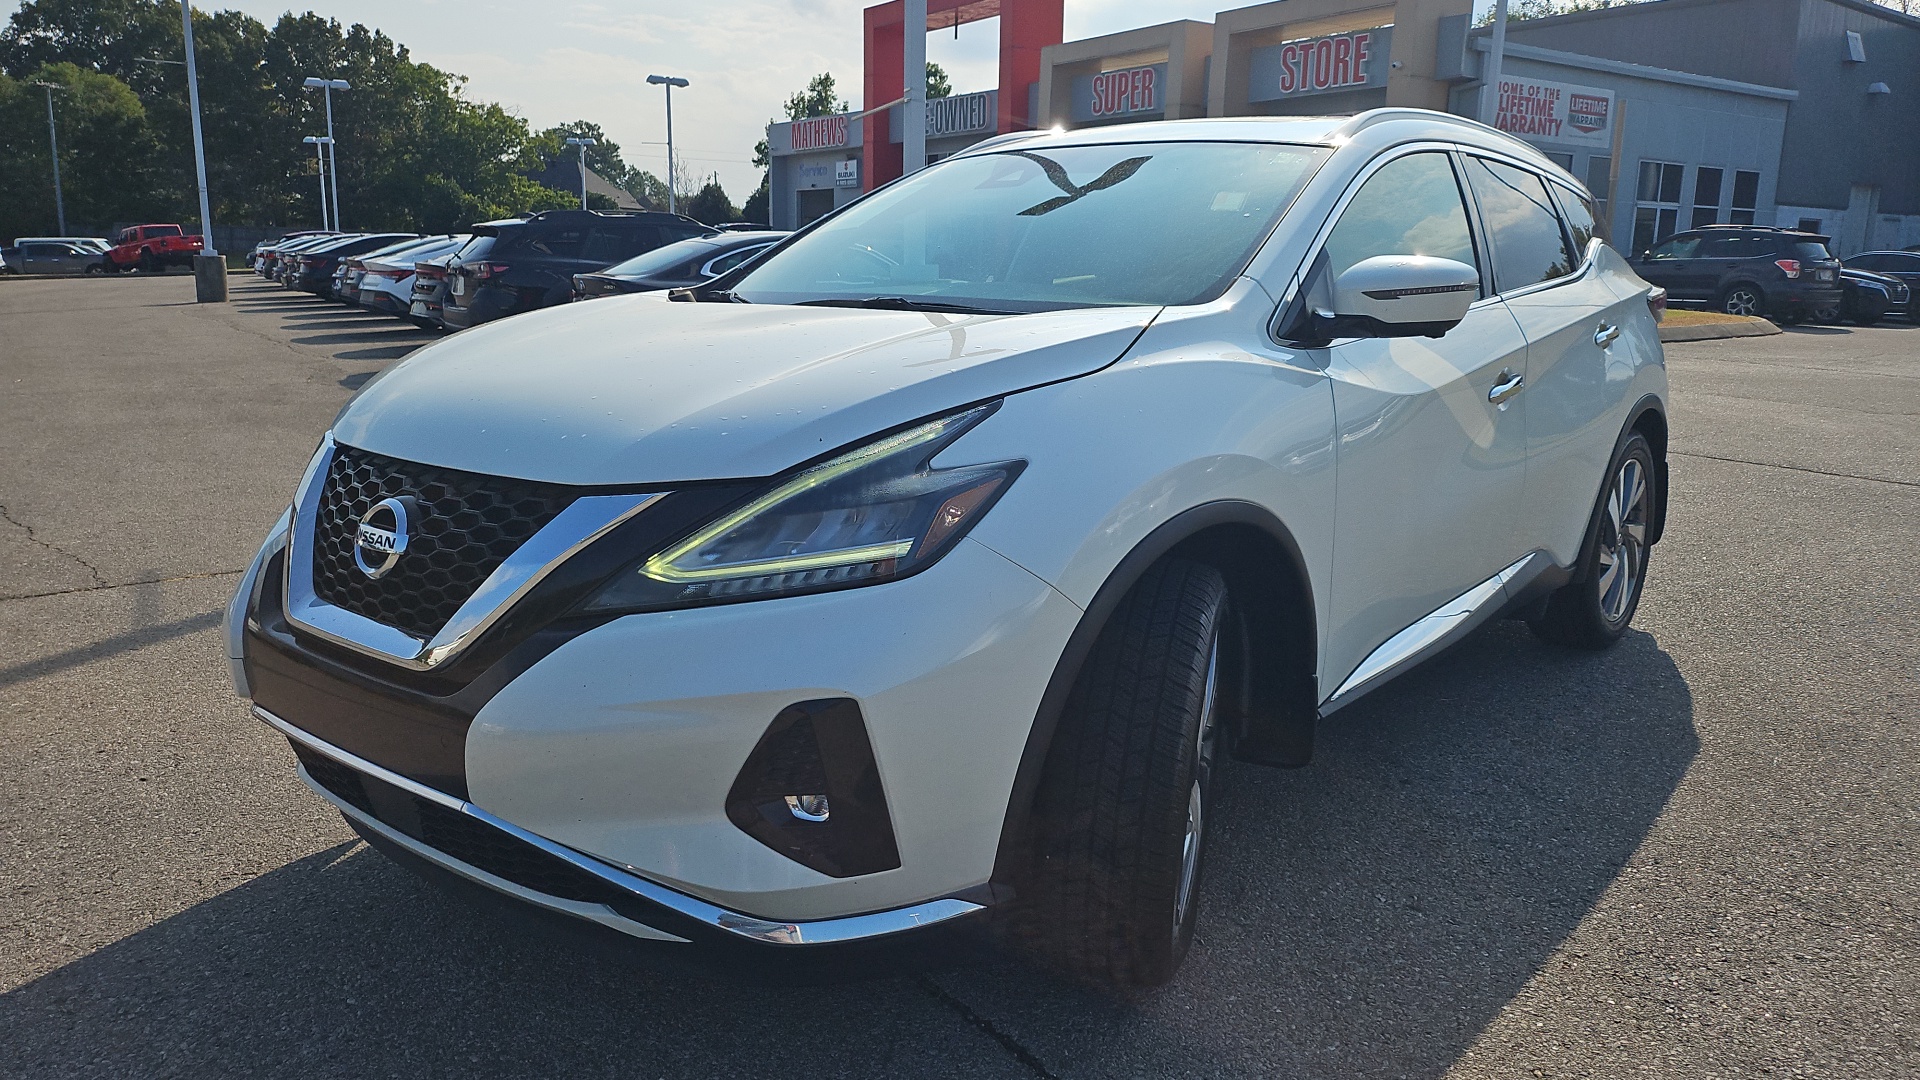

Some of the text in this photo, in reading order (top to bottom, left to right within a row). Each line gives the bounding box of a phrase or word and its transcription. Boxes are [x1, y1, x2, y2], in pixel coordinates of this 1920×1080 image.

[1280, 33, 1370, 94] STORE
[1092, 67, 1155, 115] SUPER
[1528, 85, 1540, 97] OF
[1544, 88, 1560, 100] THE
[1498, 94, 1555, 117] LIFETIME
[1570, 97, 1607, 114] LIFETIME
[791, 116, 846, 150] MATHEWS
